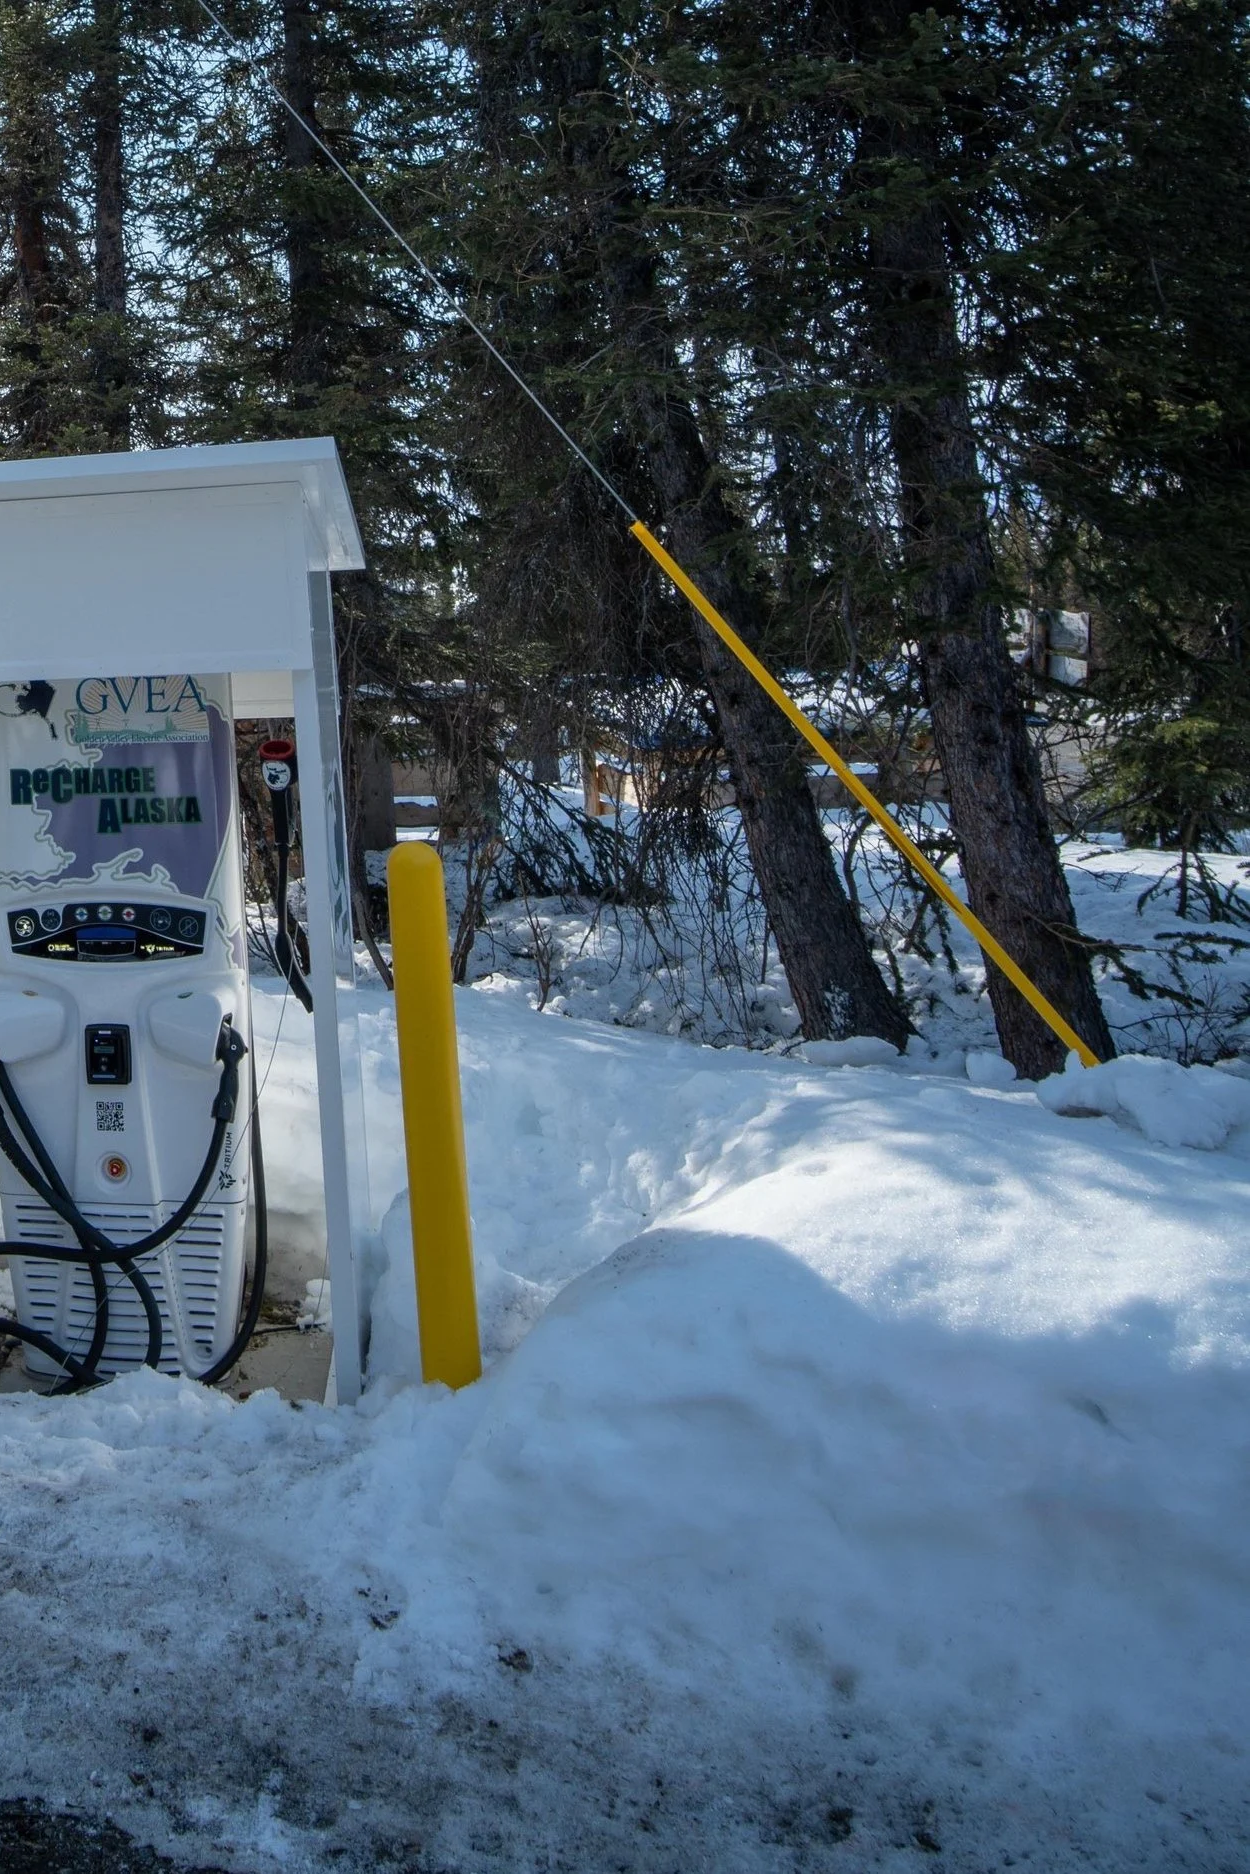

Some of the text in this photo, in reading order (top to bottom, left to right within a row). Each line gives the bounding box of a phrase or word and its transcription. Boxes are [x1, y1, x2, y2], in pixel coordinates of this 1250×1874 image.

[75, 674, 207, 714] GVEA
[75, 733, 209, 743] Golden Valley Electric Association
[224, 1132, 233, 1169] TRITIUM
